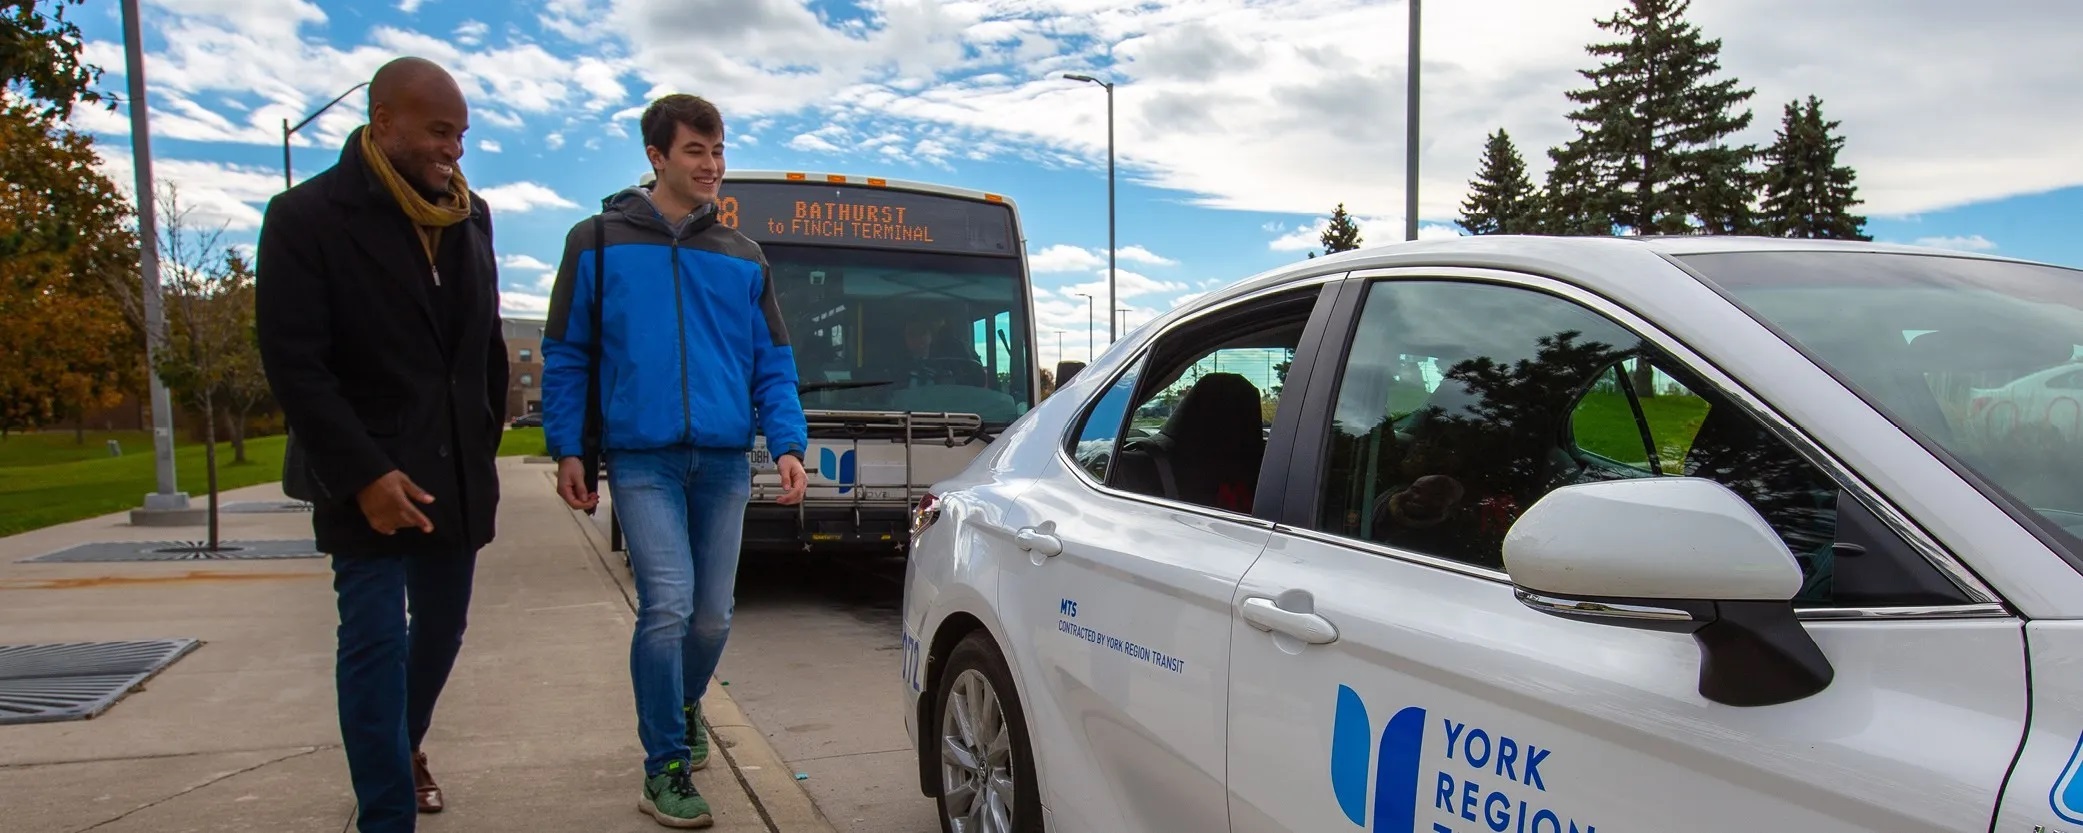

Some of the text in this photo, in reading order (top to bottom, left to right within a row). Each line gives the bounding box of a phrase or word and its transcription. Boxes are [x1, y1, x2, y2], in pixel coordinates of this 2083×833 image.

[768, 217, 934, 242] to FINCH TERMINAL
[795, 201, 906, 224] BATHURST
[1060, 598, 1078, 618] MTS
[1058, 620, 1184, 674] CONTRACTED BY YORK REGION TRANSIT
[1443, 718, 1551, 792] YORK
[1434, 771, 1596, 833] REGIO
